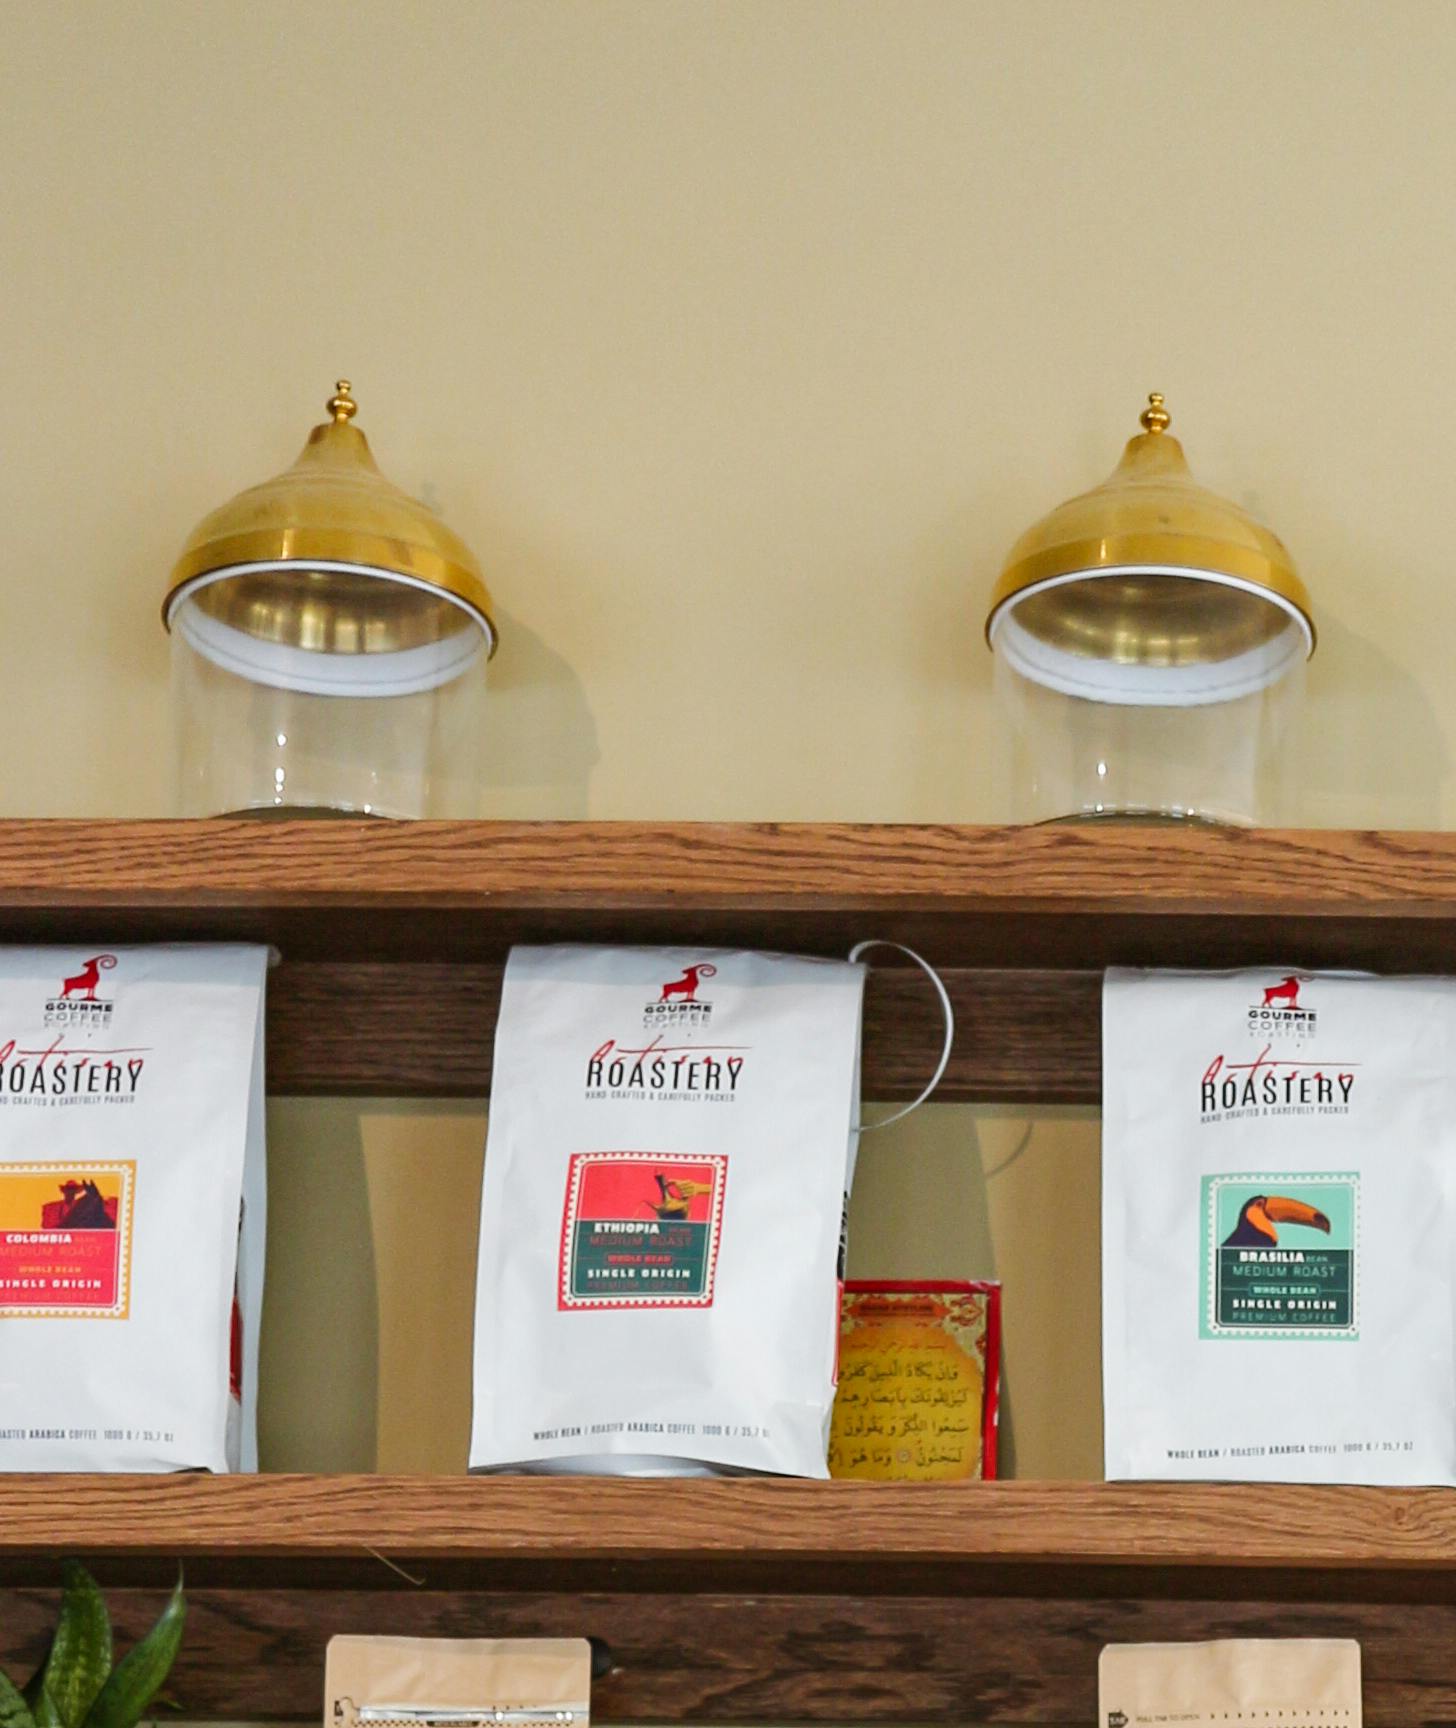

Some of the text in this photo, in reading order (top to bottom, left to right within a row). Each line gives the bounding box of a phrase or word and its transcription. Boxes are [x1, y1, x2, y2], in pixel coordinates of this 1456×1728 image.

[45, 1002, 113, 1012] GOURME
[644, 1004, 712, 1013] GOURME
[44, 1012, 112, 1022] COFFEE
[643, 1013, 711, 1023] COFFEE
[1248, 1010, 1317, 1021] GOURME
[1248, 1020, 1317, 1032] COFFEE
[586, 1060, 742, 1091] ROASTERY
[1201, 1078, 1353, 1112] ROASTERY
[594, 1222, 660, 1234] ETHIOPIA
[6, 1234, 72, 1244] COLOMBIA
[1239, 1251, 1305, 1263] BRASILIA
[587, 1269, 691, 1279] SINGLE ORIGIN
[1232, 1266, 1337, 1277] MEDIUM ROAST
[52, 1279, 102, 1289] ORIGIN
[1253, 1287, 1316, 1295] WHOLE BEAN
[1232, 1299, 1336, 1309] SINGLE ORIGIN
